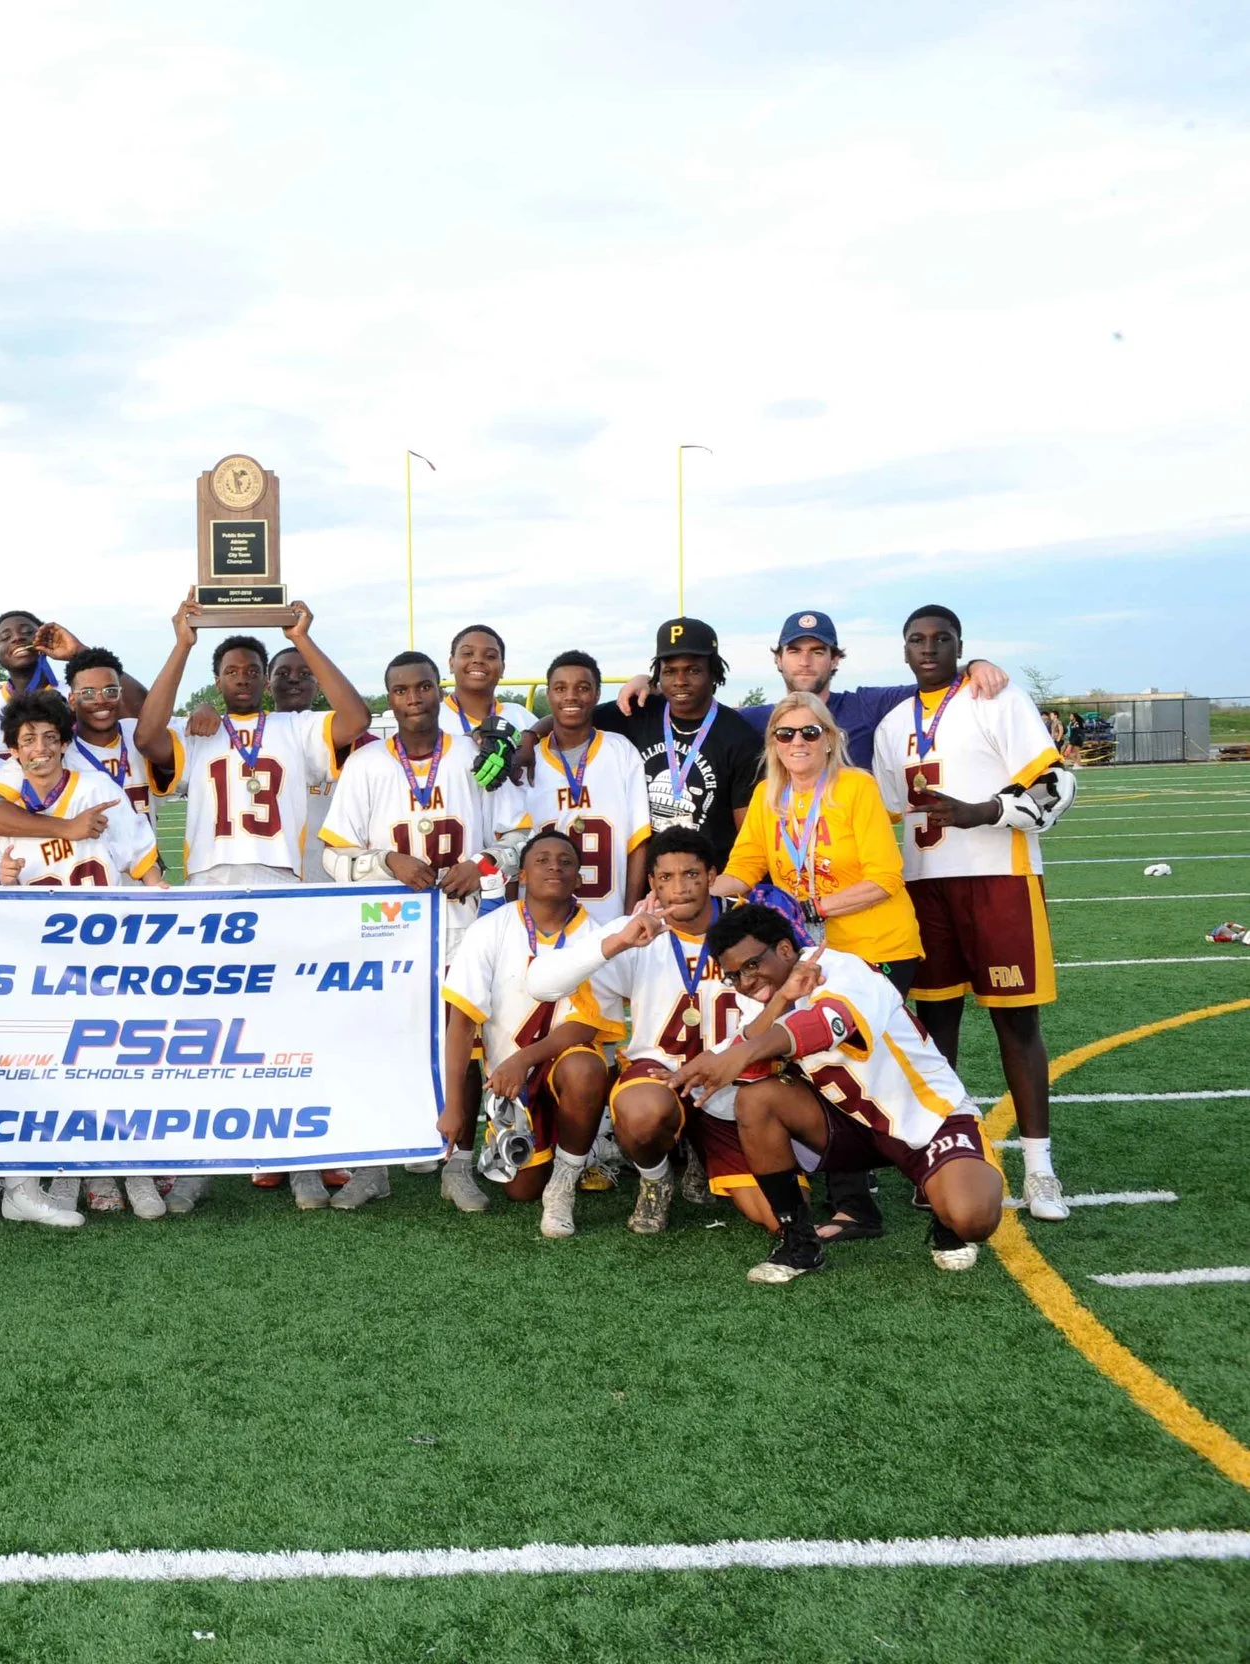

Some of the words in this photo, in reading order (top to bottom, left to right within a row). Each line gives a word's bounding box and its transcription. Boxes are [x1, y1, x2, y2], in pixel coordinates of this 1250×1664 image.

[670, 625, 684, 644] P
[207, 754, 287, 840] 13
[775, 815, 832, 852] FA
[40, 838, 74, 866] FDA
[361, 901, 421, 922] NYC
[40, 910, 259, 945] 2017-18
[361, 924, 401, 932] Department
[31, 963, 276, 996] LACROSSE
[988, 965, 1025, 988] FDA
[64, 1068, 145, 1080] SCHOOLS
[925, 1132, 976, 1168] FDA
